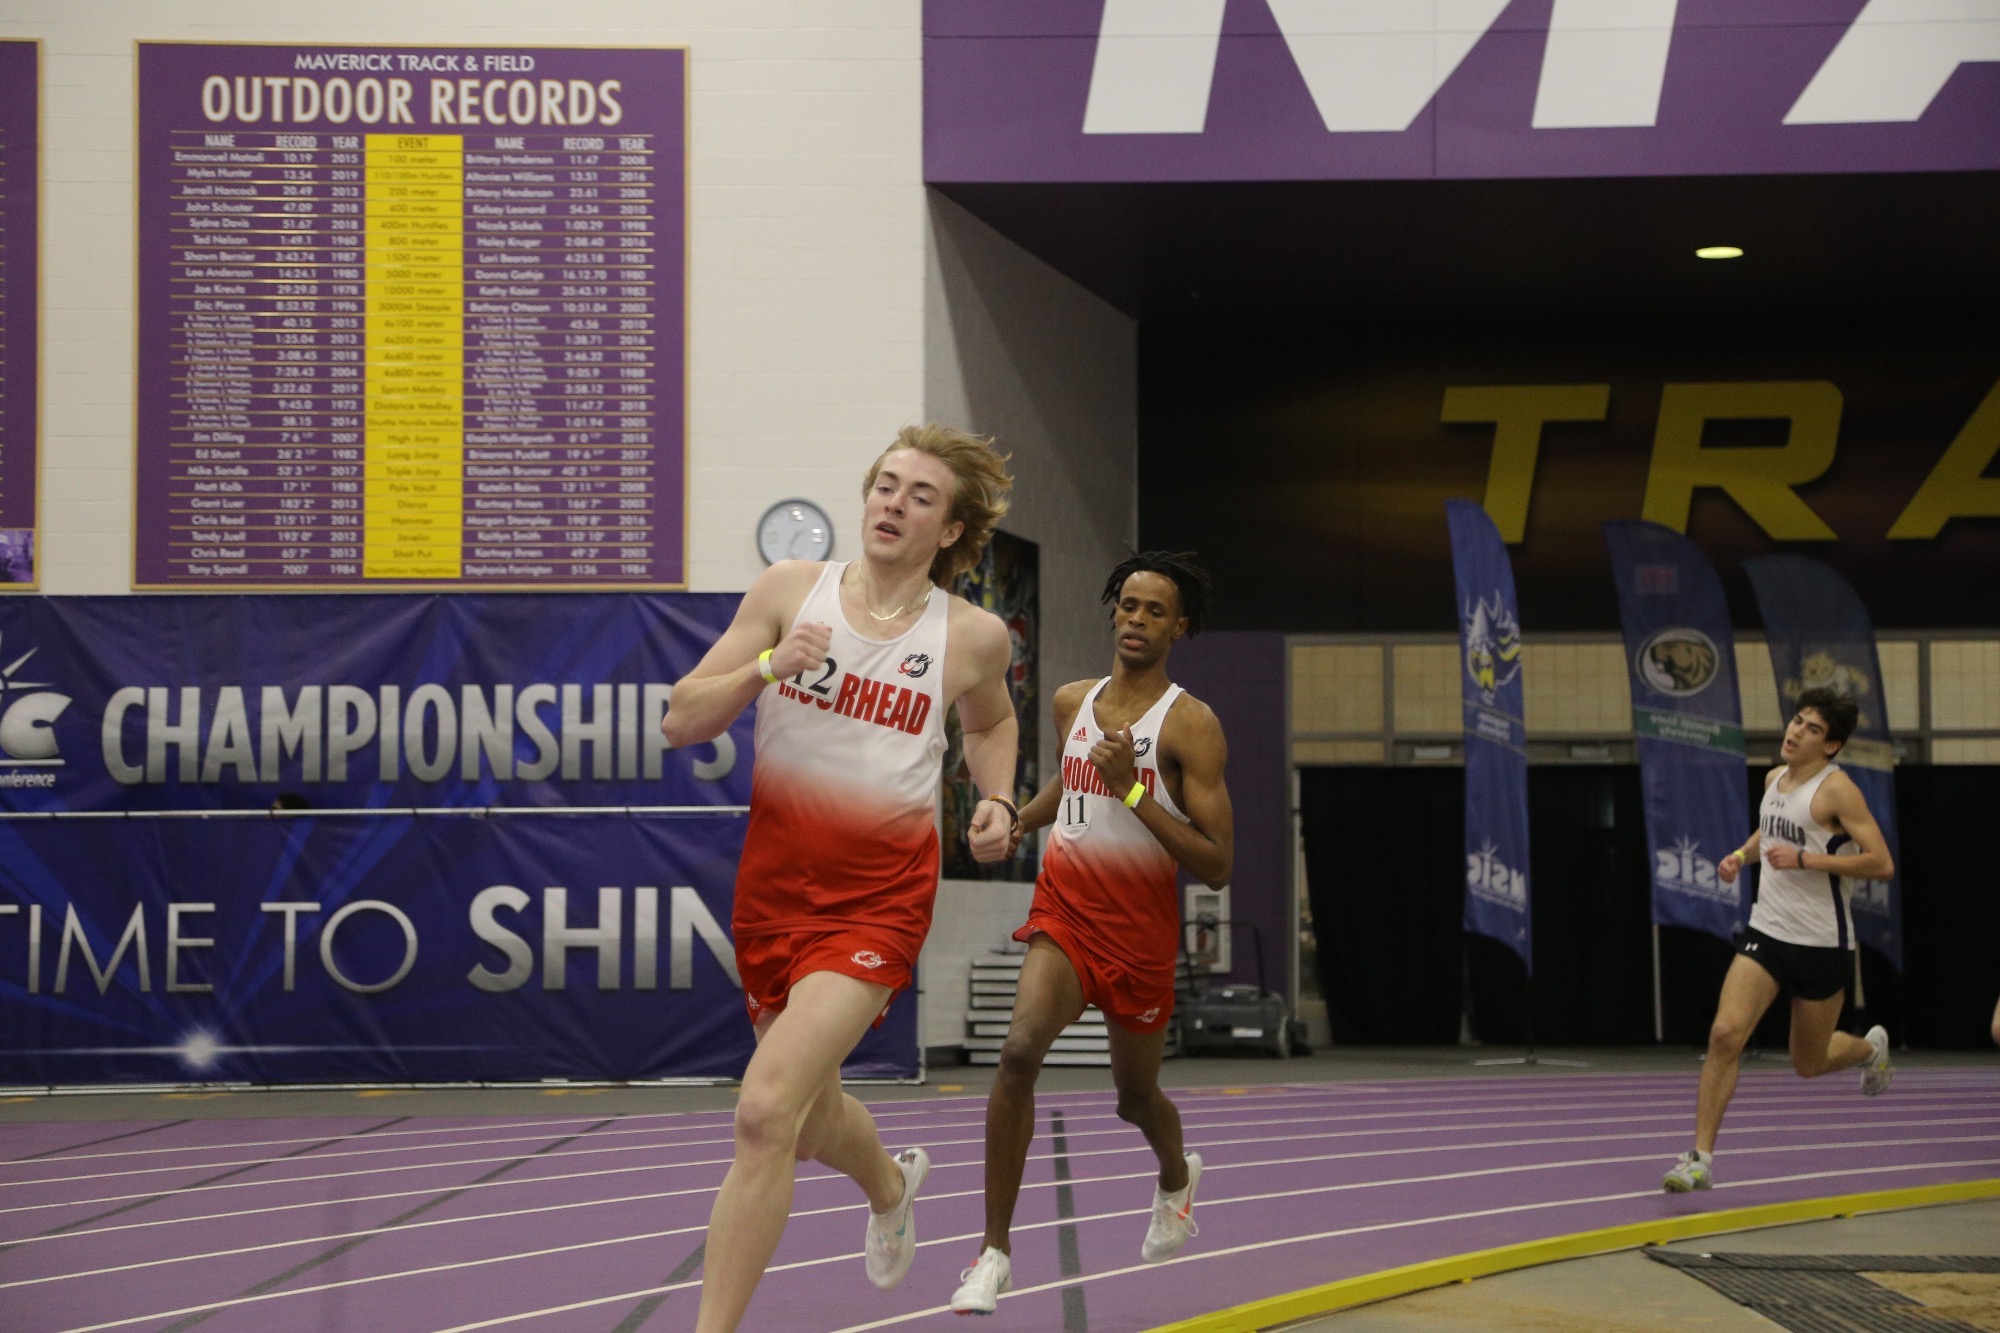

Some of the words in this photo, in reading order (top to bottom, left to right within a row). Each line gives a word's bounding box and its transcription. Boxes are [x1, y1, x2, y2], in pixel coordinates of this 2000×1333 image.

[294, 54, 392, 71] MAVERICK
[398, 55, 459, 72] TRACK
[464, 56, 478, 72] &
[484, 56, 535, 72] FIELD
[202, 75, 415, 123] OUTDOOR
[430, 79, 623, 126] RECORDS
[204, 134, 235, 147] NAME
[276, 136, 317, 148] RECORD
[332, 136, 359, 148] YEAR
[398, 137, 428, 148] EVENT
[495, 137, 525, 149] NAME
[563, 138, 604, 150] RECORD
[619, 138, 646, 150] YEAR
[778, 672, 932, 736] RHEAD
[1066, 794, 1088, 826] 11
[0, 901, 216, 996] IME
[260, 899, 419, 996] TO
